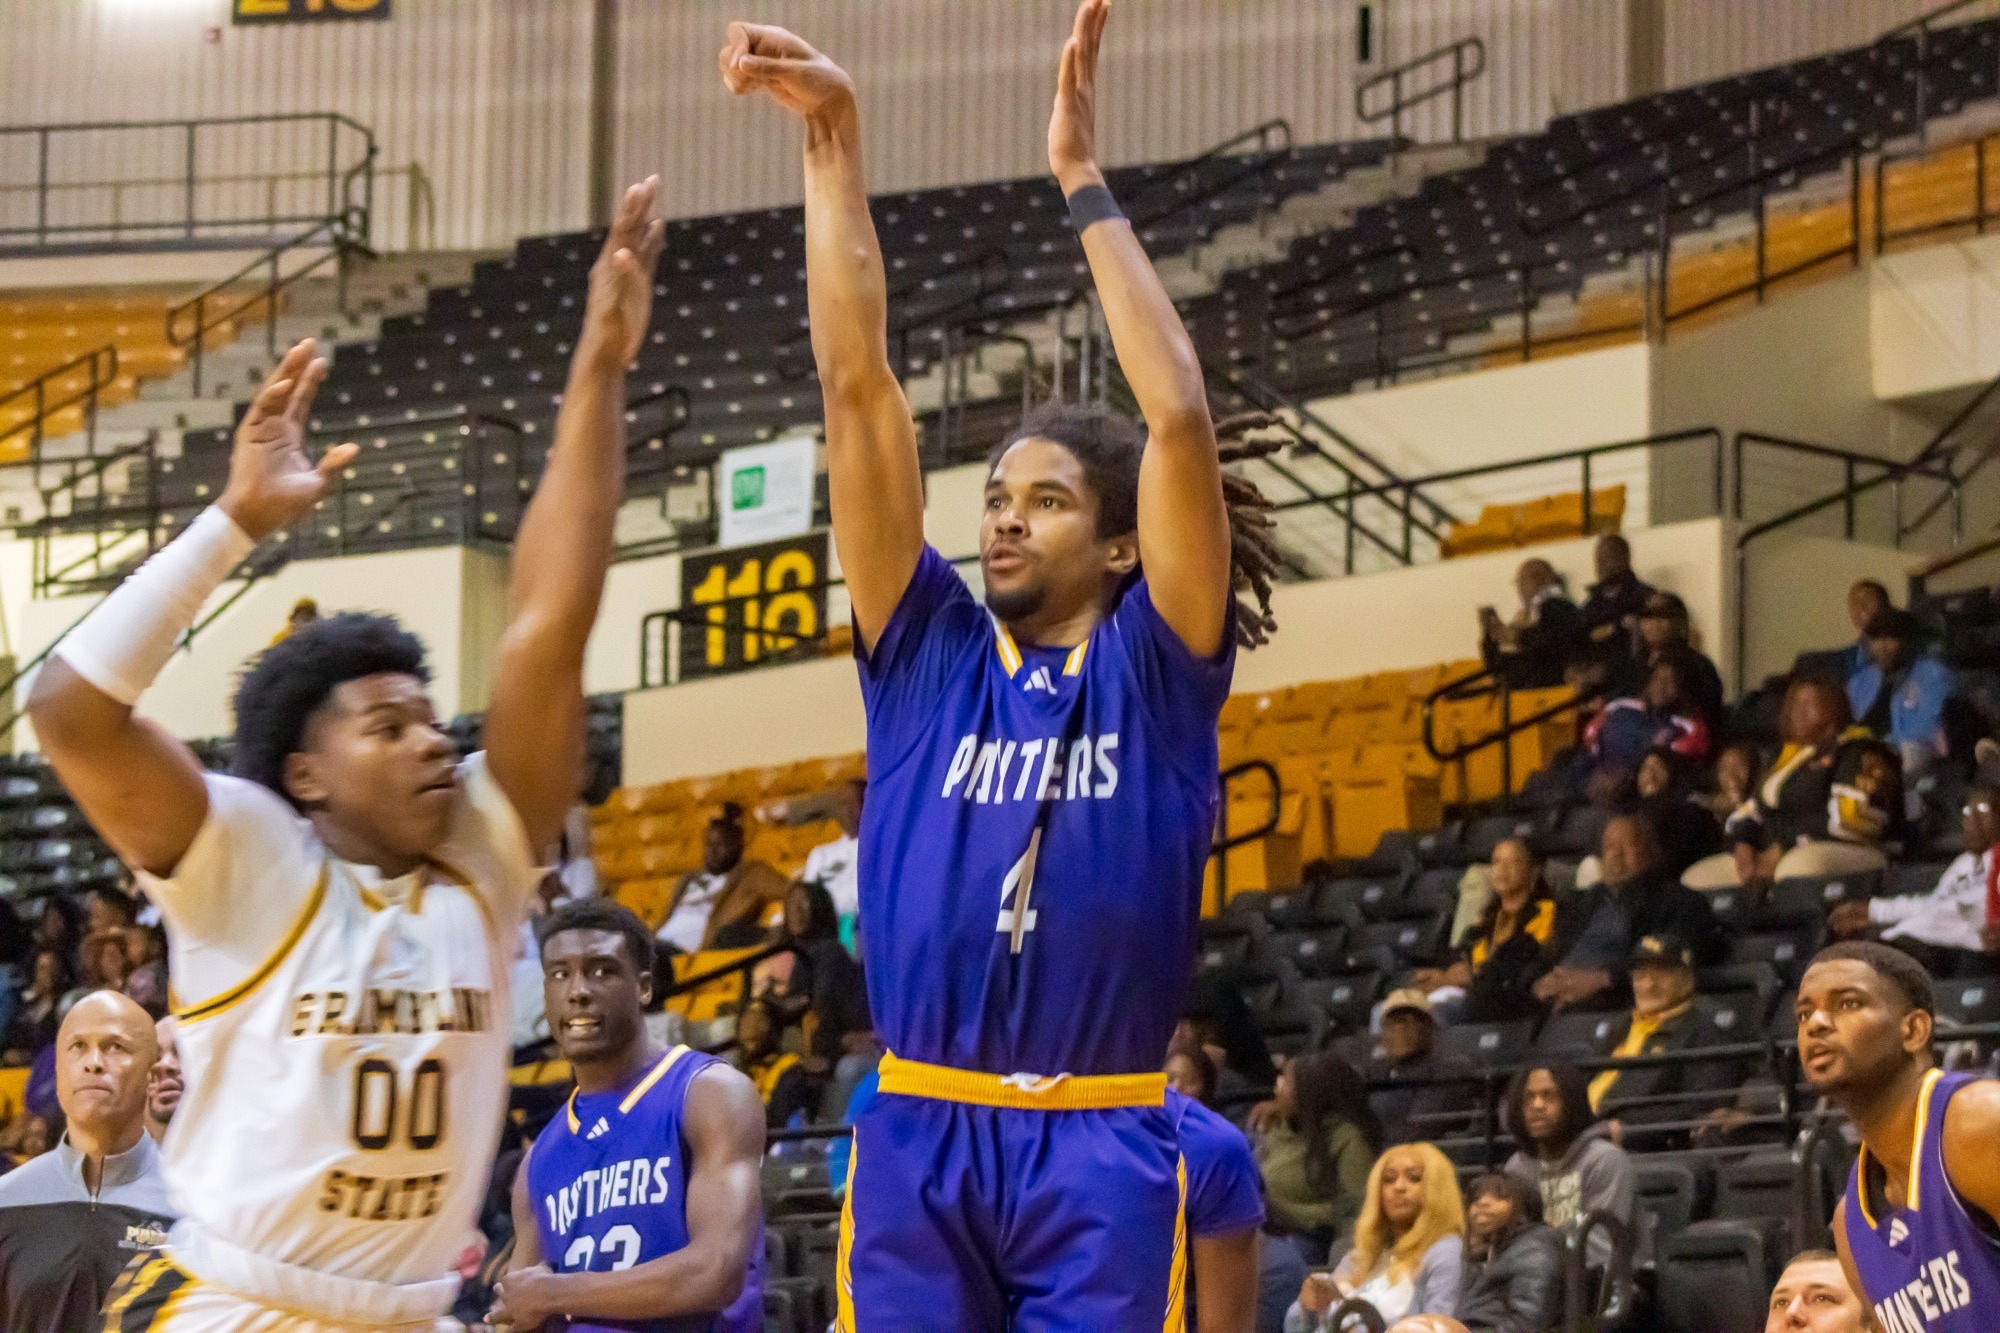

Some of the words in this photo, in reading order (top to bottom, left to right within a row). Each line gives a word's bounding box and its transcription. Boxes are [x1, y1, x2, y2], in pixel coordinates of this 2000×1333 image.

[941, 732, 1119, 804] PANTERS
[996, 826, 1038, 954] 4
[355, 1058, 443, 1149] 00
[1874, 1249, 1971, 1333] PANTERS
